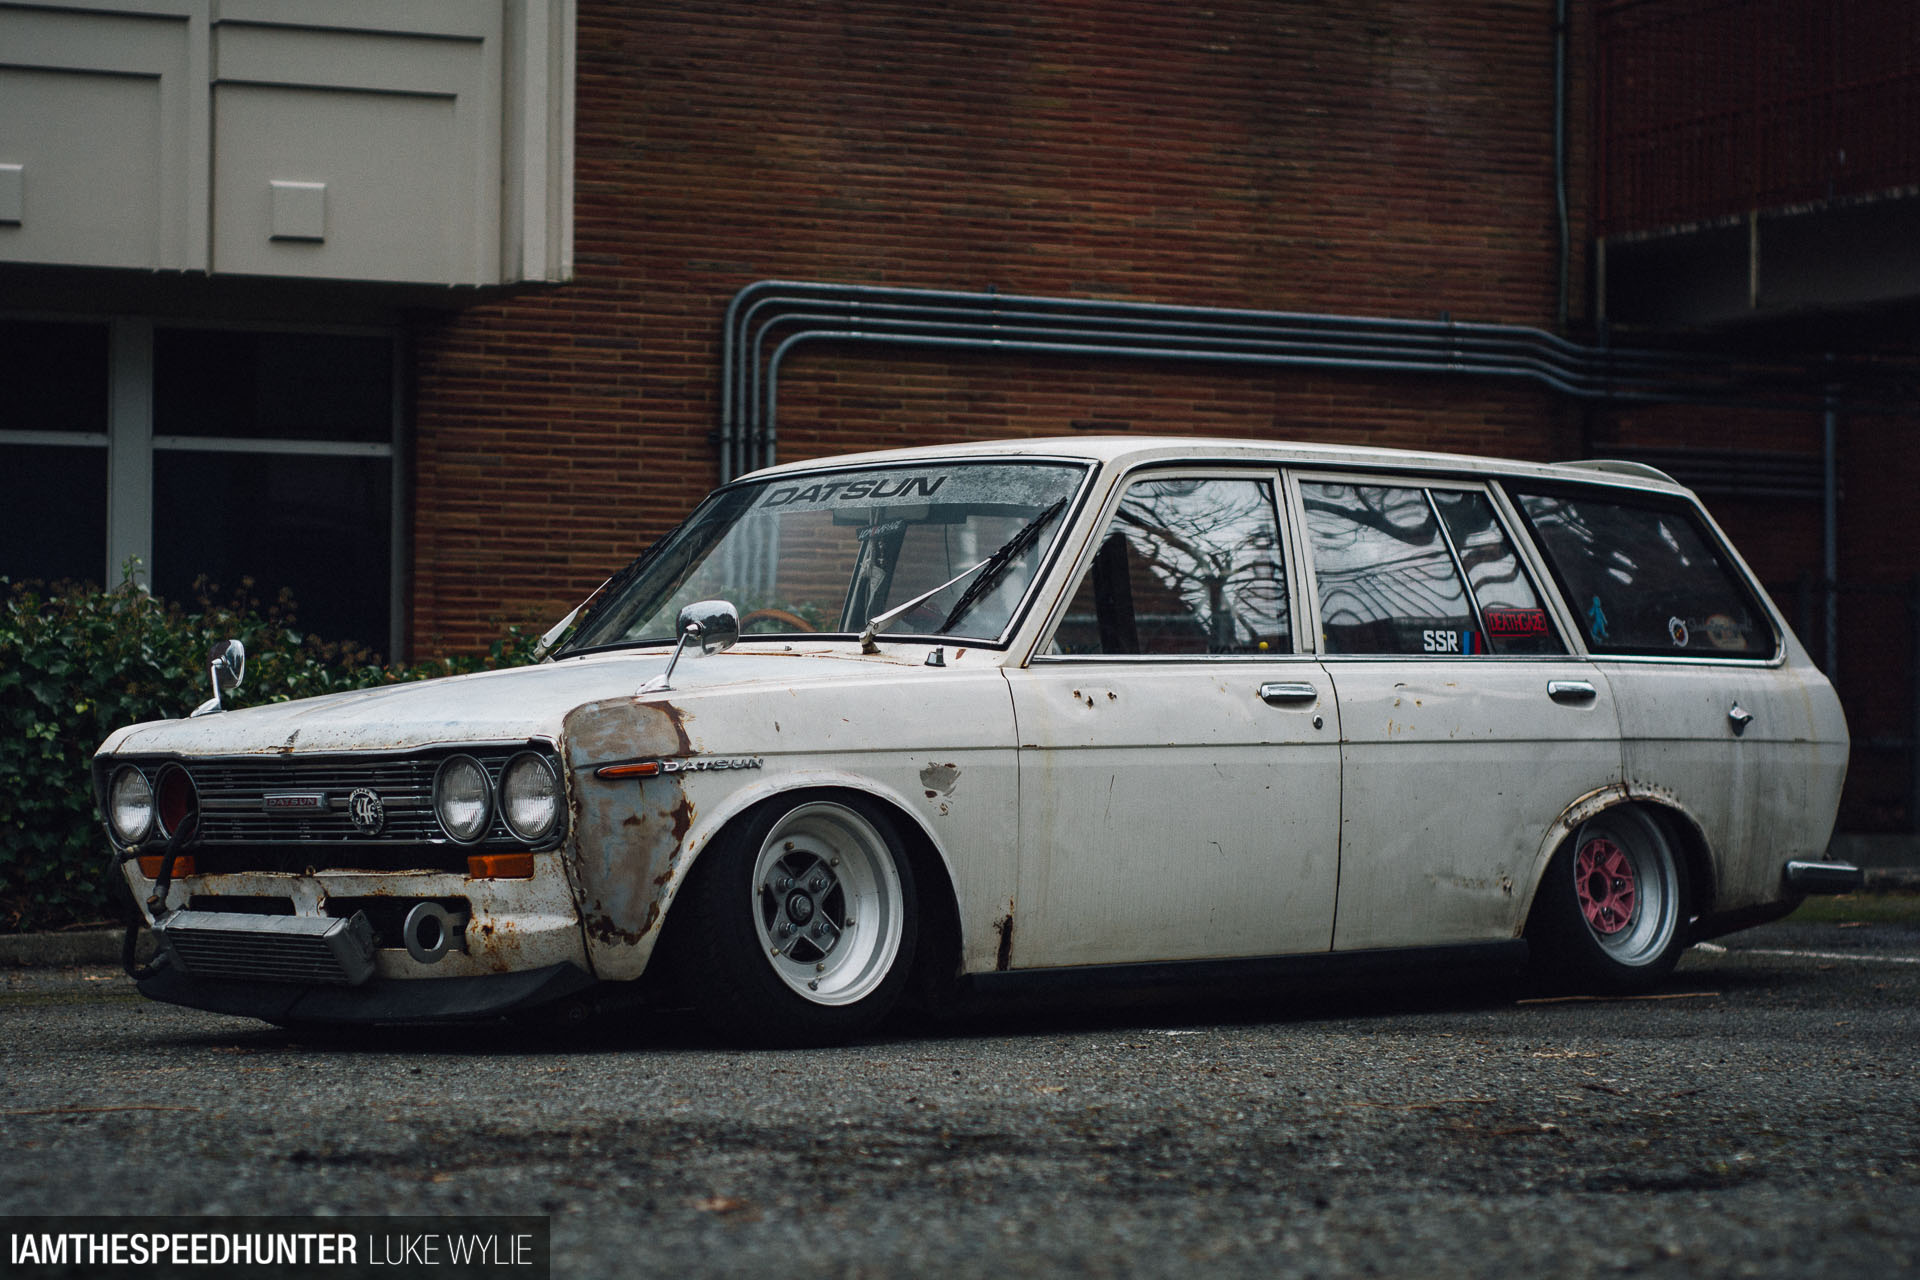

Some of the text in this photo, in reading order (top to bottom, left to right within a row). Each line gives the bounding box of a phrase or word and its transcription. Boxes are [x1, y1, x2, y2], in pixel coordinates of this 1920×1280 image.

[759, 476, 948, 509] DATSUN
[1487, 612, 1546, 632] DEATHGAZE
[1423, 630, 1459, 652] SSR
[663, 758, 764, 773] DATSUN
[268, 798, 316, 807] DATSUN
